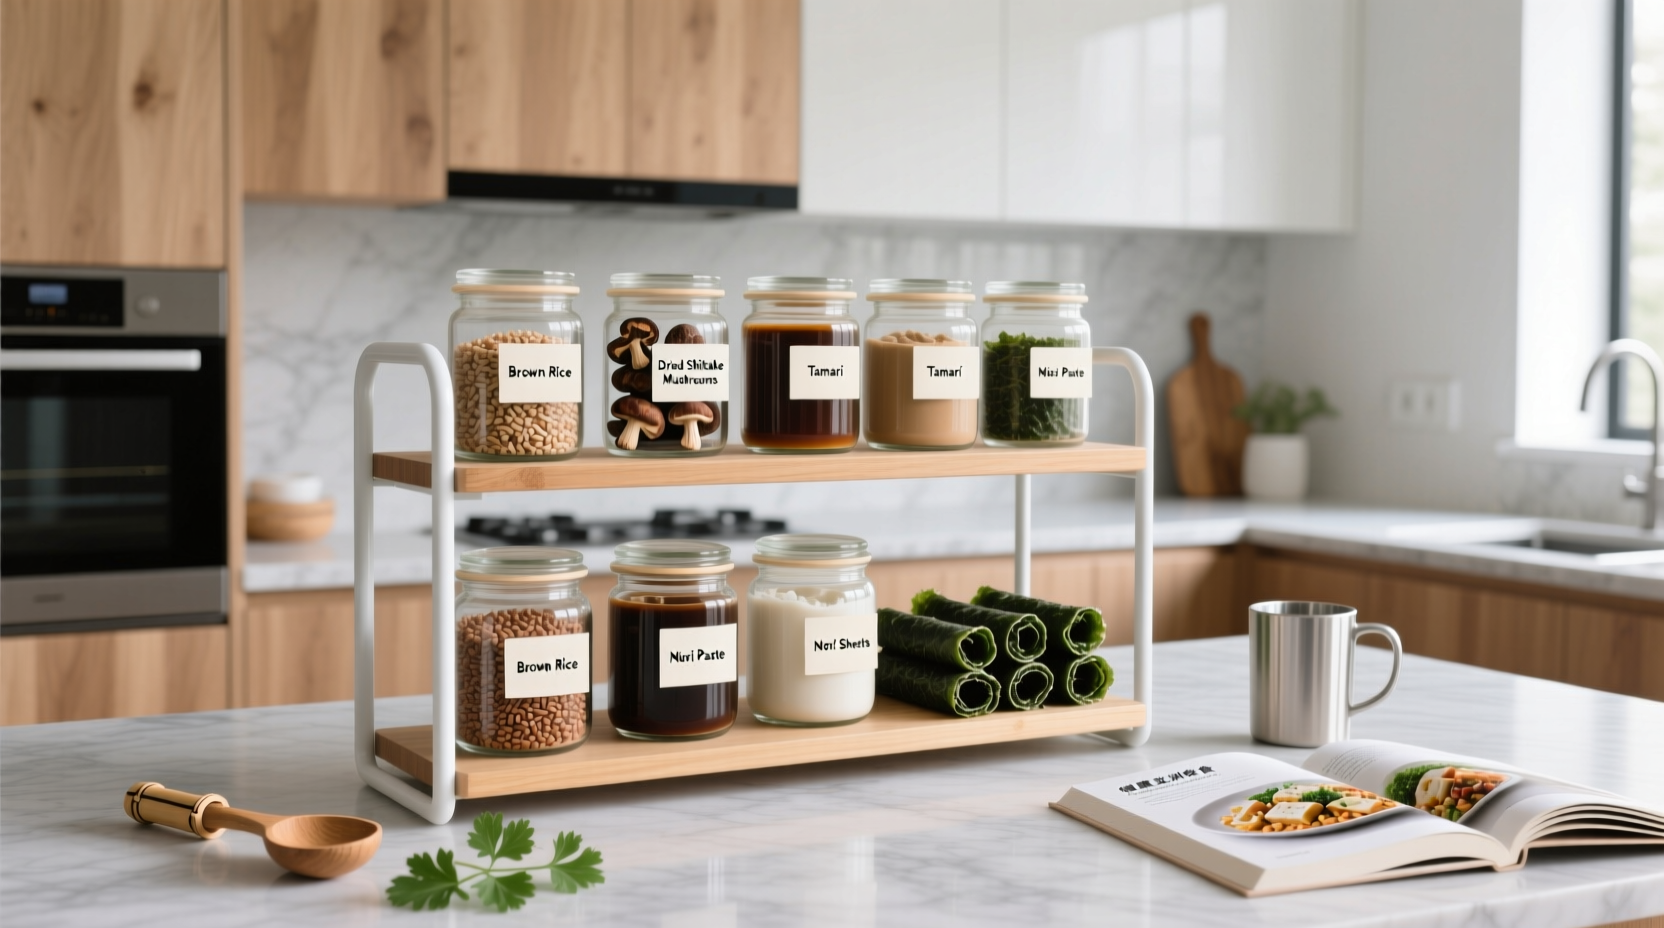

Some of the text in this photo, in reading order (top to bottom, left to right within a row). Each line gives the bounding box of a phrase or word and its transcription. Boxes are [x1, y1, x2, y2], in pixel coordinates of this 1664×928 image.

[508, 365, 572, 378] Brown Rice
[807, 365, 844, 377] Tamari
[554, 657, 579, 671] Rice
